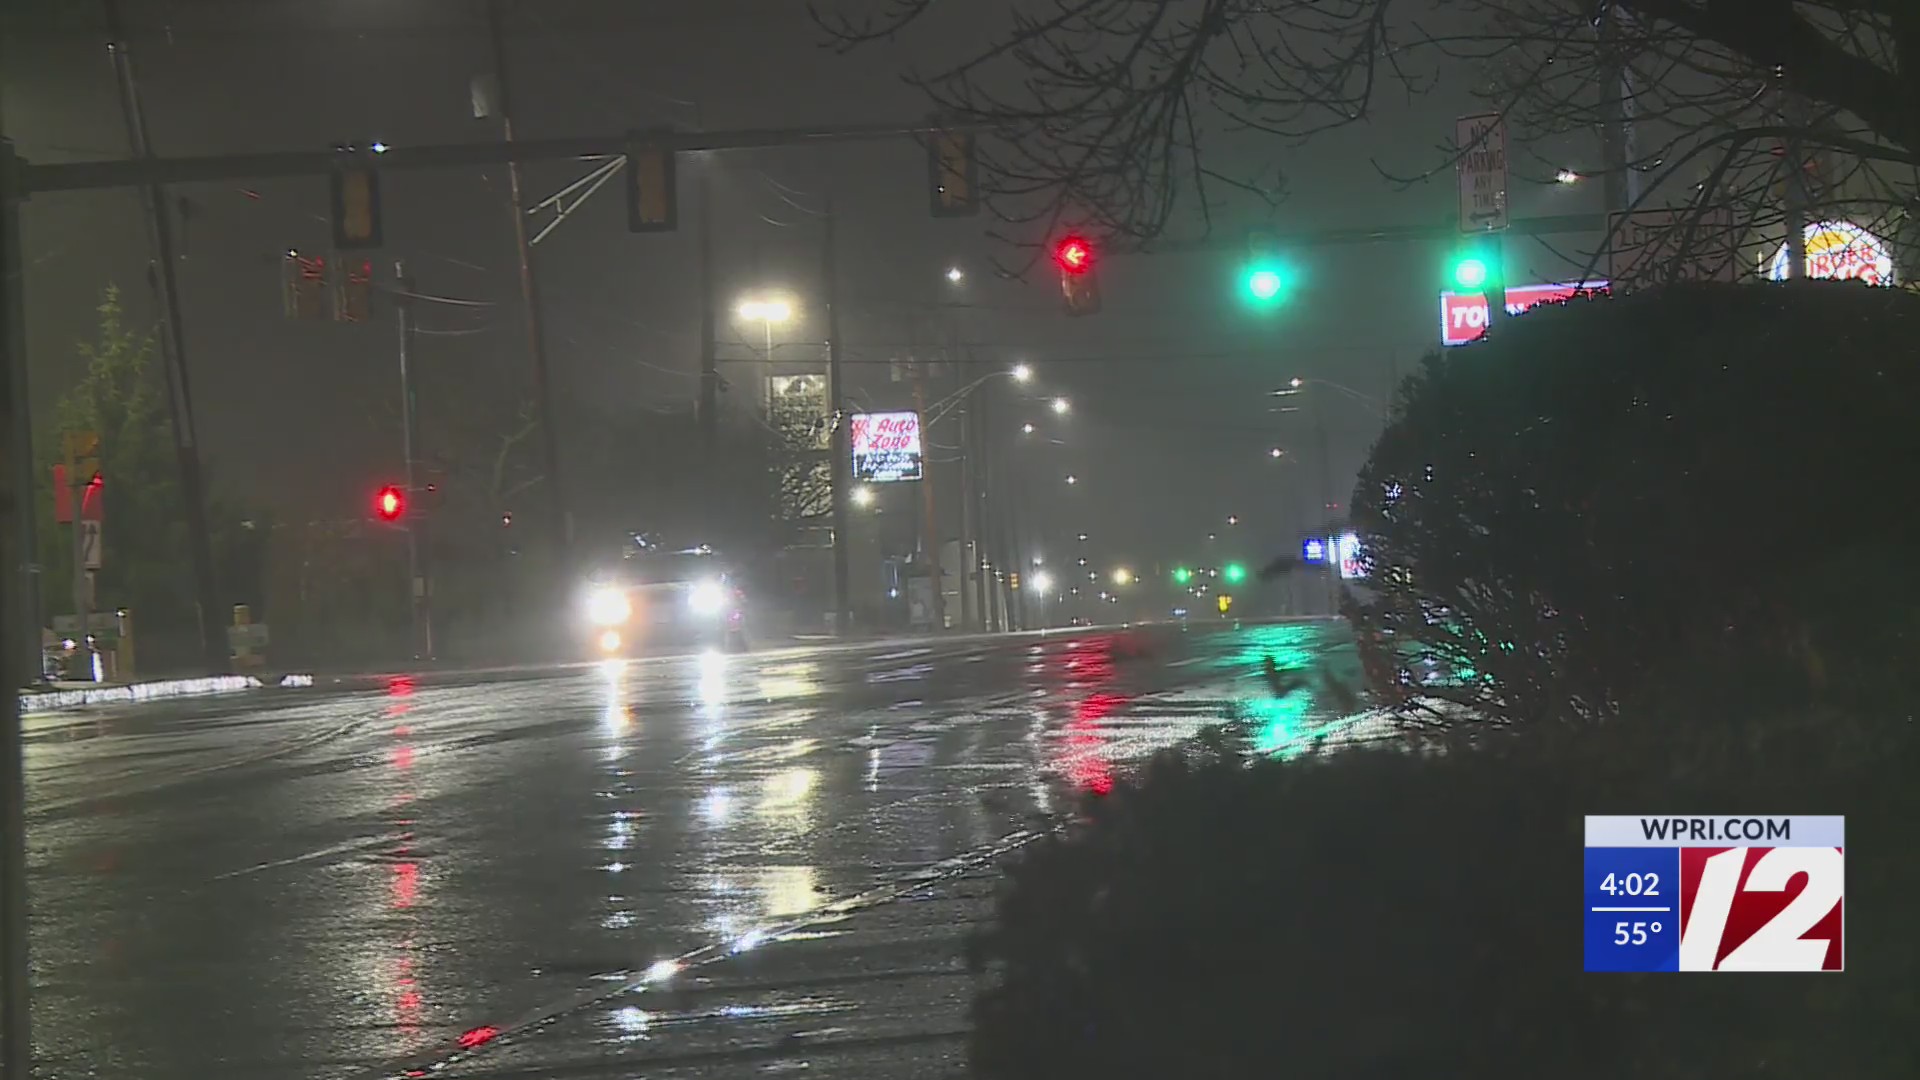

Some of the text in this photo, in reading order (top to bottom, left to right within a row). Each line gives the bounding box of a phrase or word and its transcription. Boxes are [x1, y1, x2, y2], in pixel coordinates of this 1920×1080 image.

[1460, 149, 1503, 174] PARKING
[1474, 176, 1493, 190] ANY
[877, 418, 916, 433] Auto
[868, 434, 911, 449] Zone
